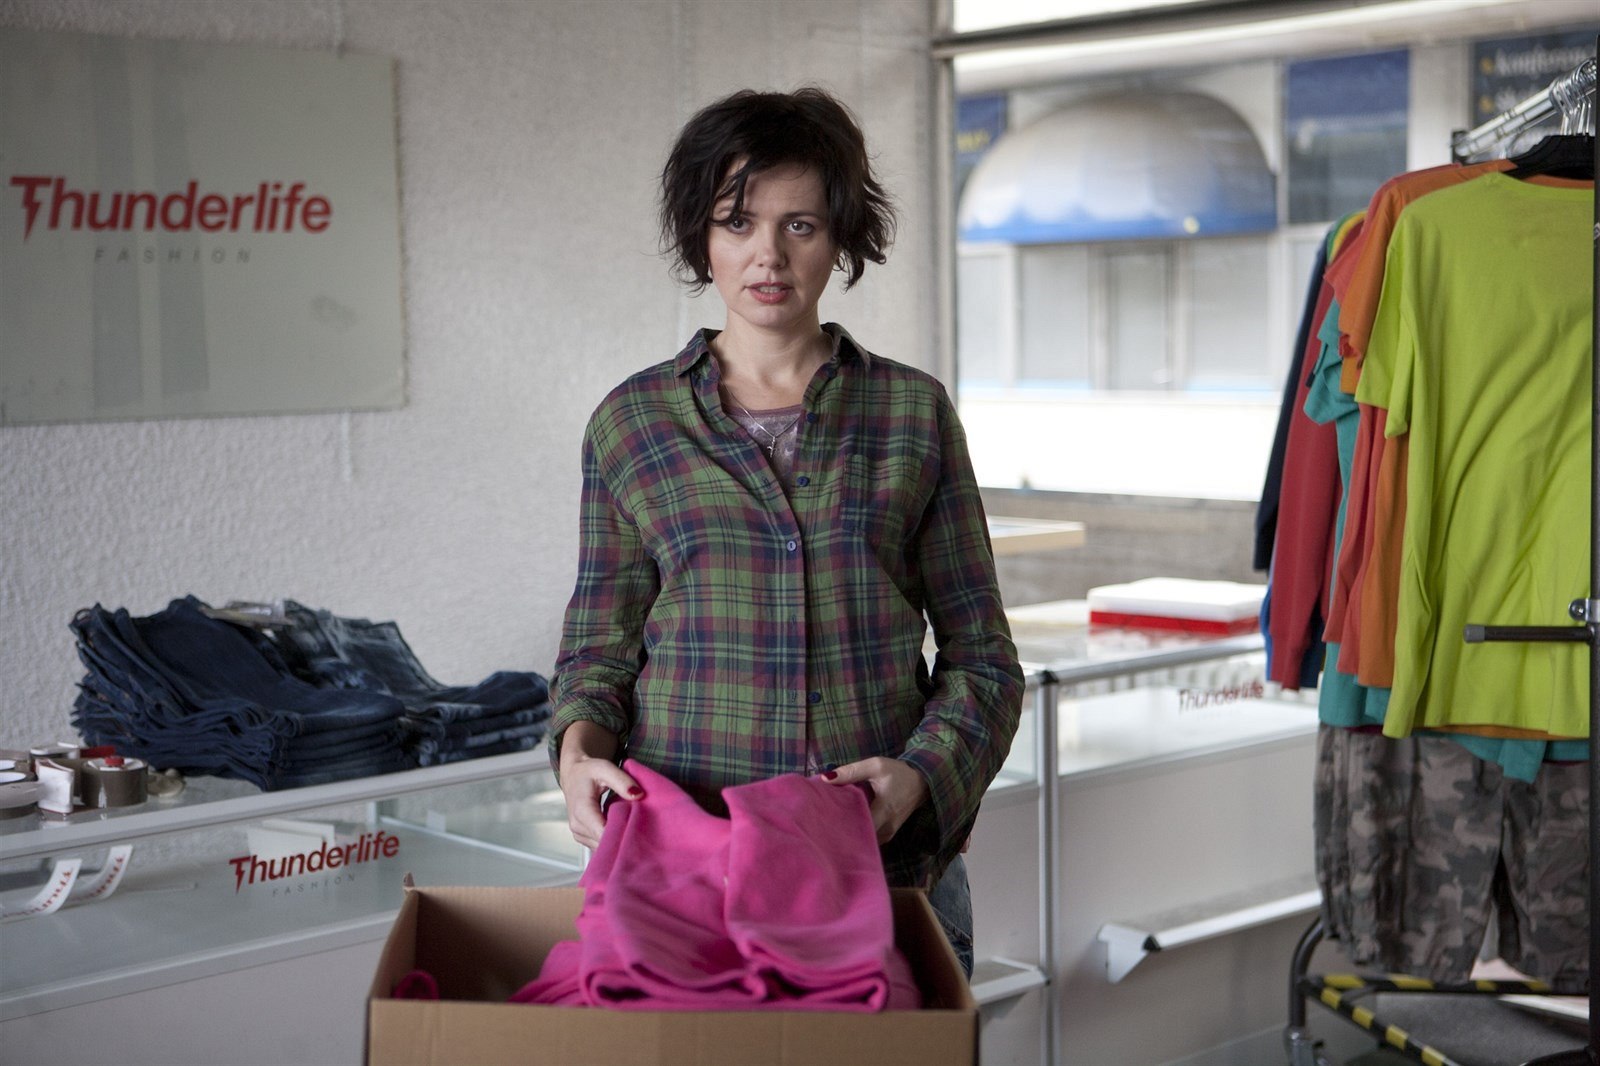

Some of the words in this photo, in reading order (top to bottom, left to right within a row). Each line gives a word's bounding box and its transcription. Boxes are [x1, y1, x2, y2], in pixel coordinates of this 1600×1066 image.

[10, 175, 333, 242] Thunderlife
[94, 247, 252, 264] FASHION
[1178, 680, 1265, 713] Thunderlife
[229, 830, 400, 893] Thunderlife
[272, 873, 356, 897] FASHION
